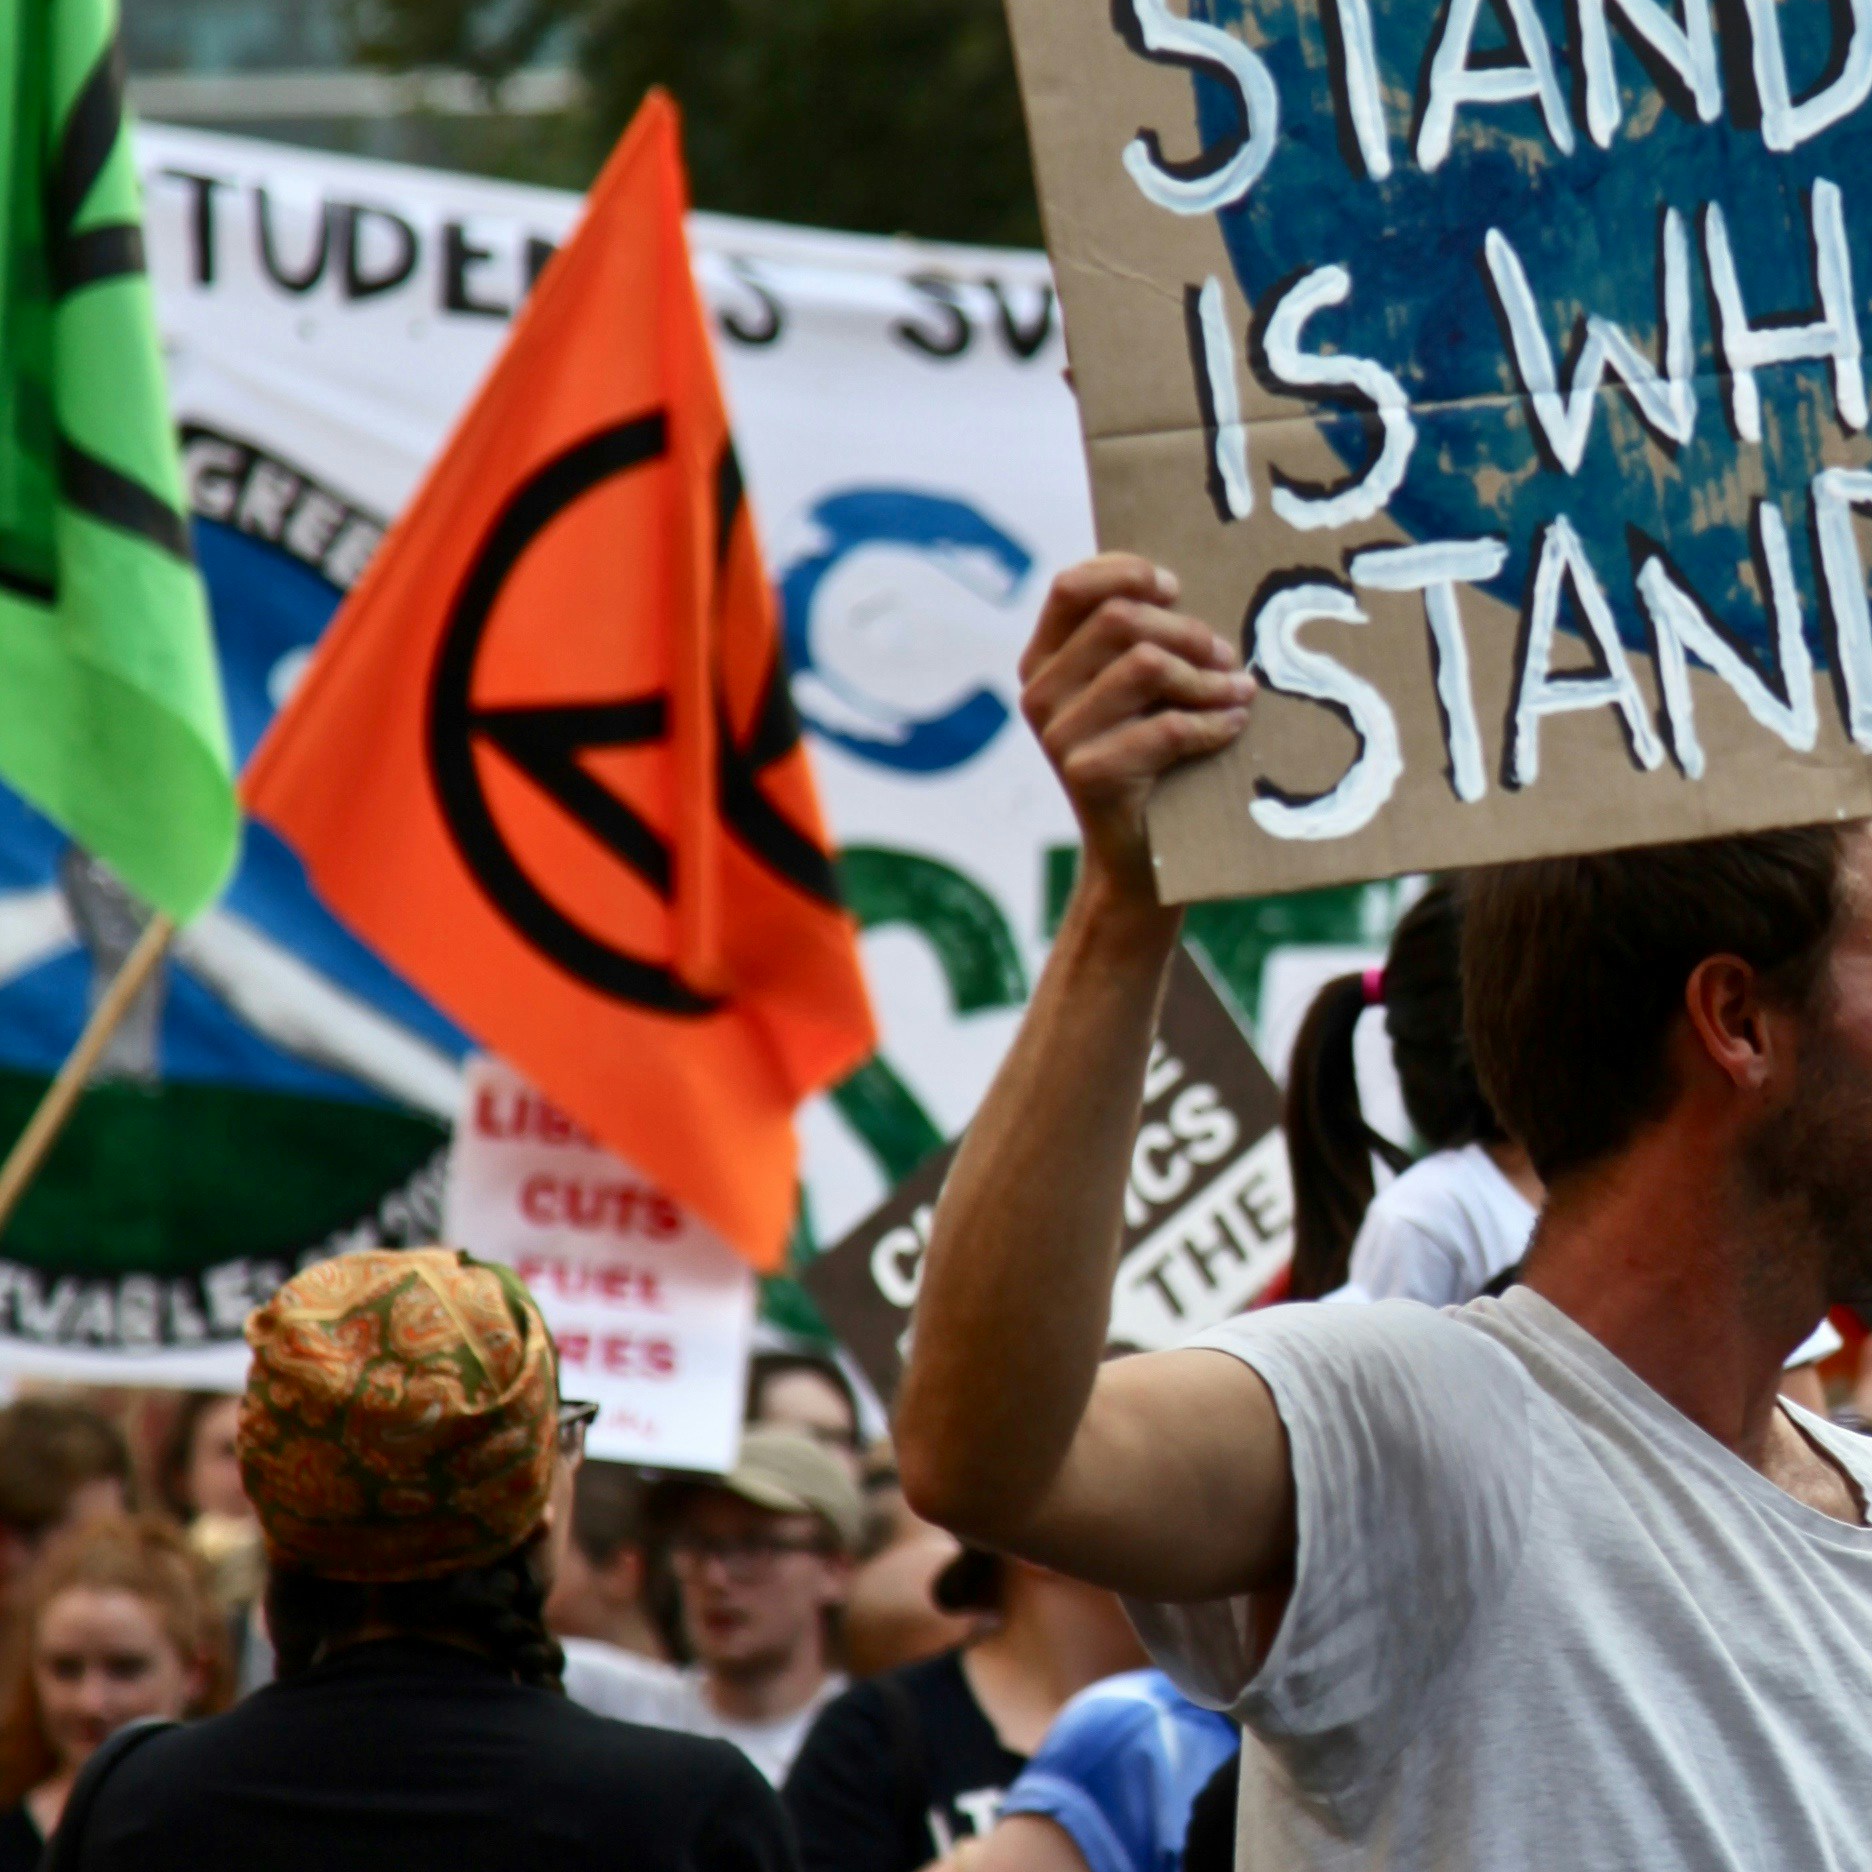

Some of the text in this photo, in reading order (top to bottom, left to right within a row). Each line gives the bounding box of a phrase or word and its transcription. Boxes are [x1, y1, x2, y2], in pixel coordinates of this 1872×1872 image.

[1187, 261, 1416, 532] IS
[519, 1175, 683, 1244] CUTS
[1132, 1171, 1291, 1319] THE
